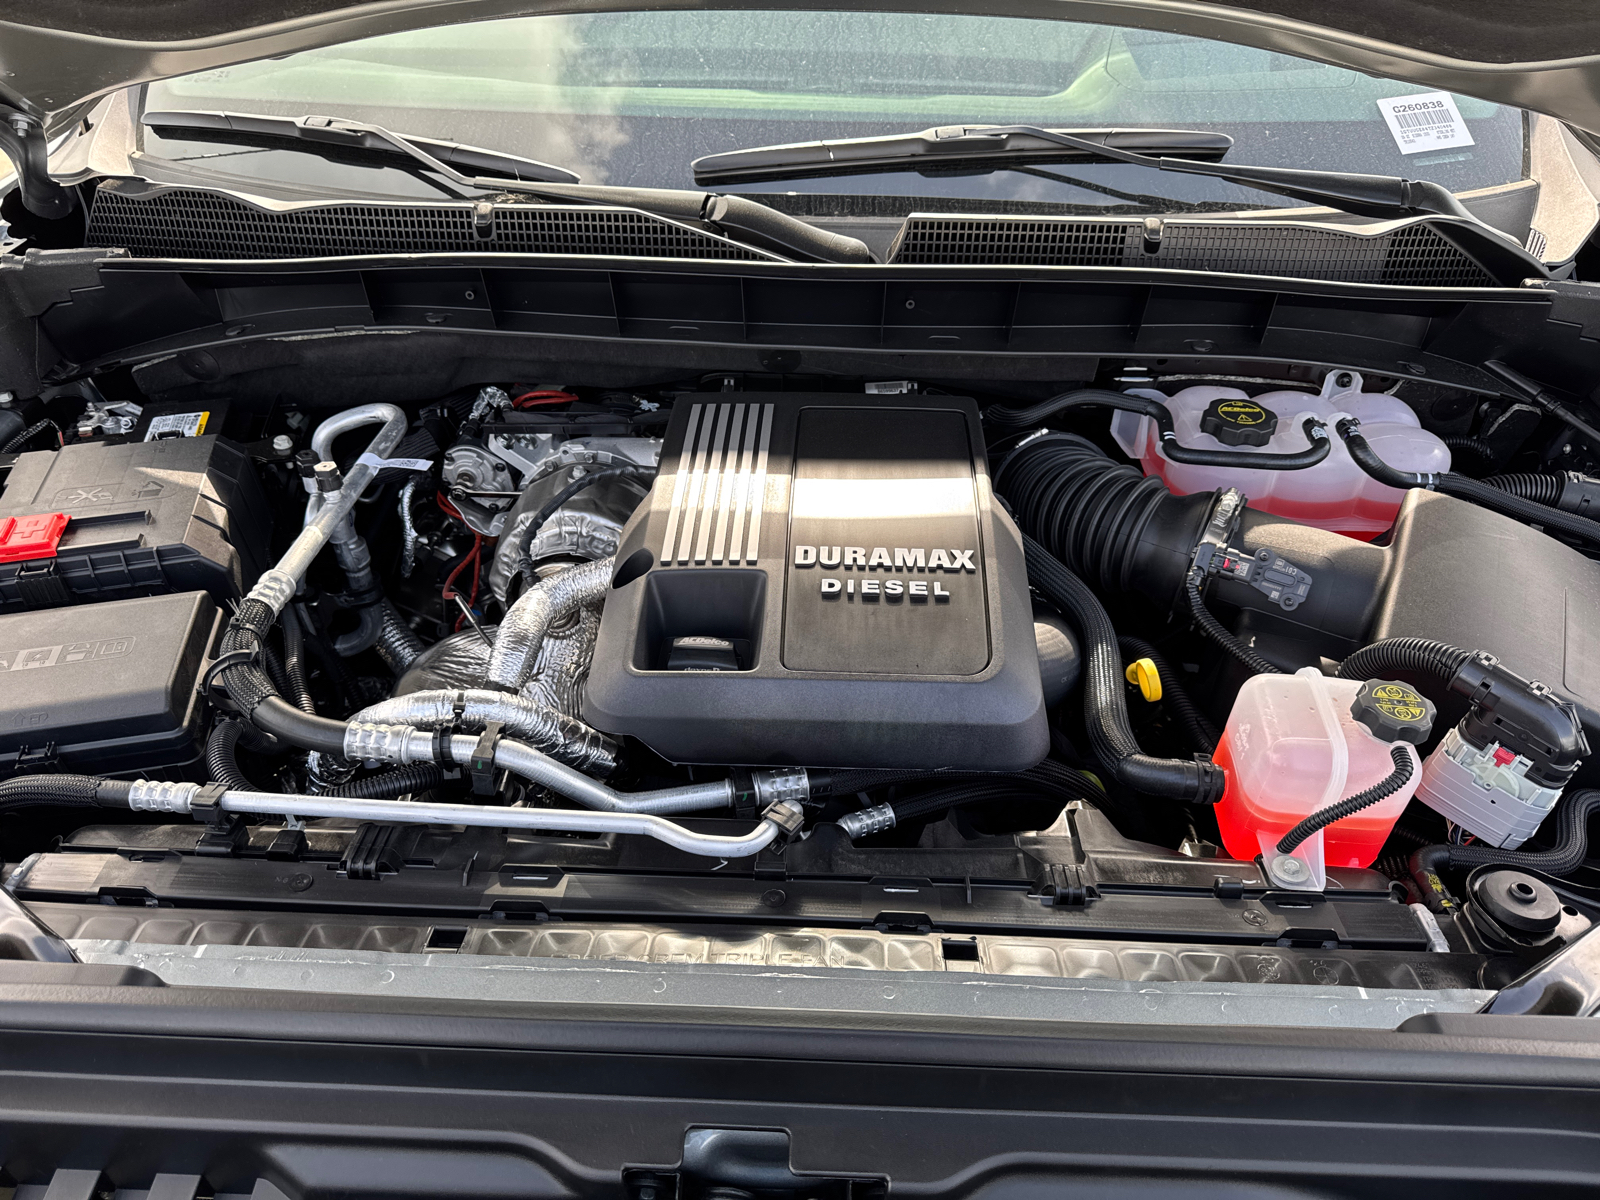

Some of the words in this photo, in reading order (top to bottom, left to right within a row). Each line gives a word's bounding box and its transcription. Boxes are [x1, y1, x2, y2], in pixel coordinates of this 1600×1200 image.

[795, 546, 976, 571] DURAMAX
[821, 579, 950, 597] DIESEL
[678, 637, 730, 646] ACDelco
[801, 954, 845, 967] FAN
